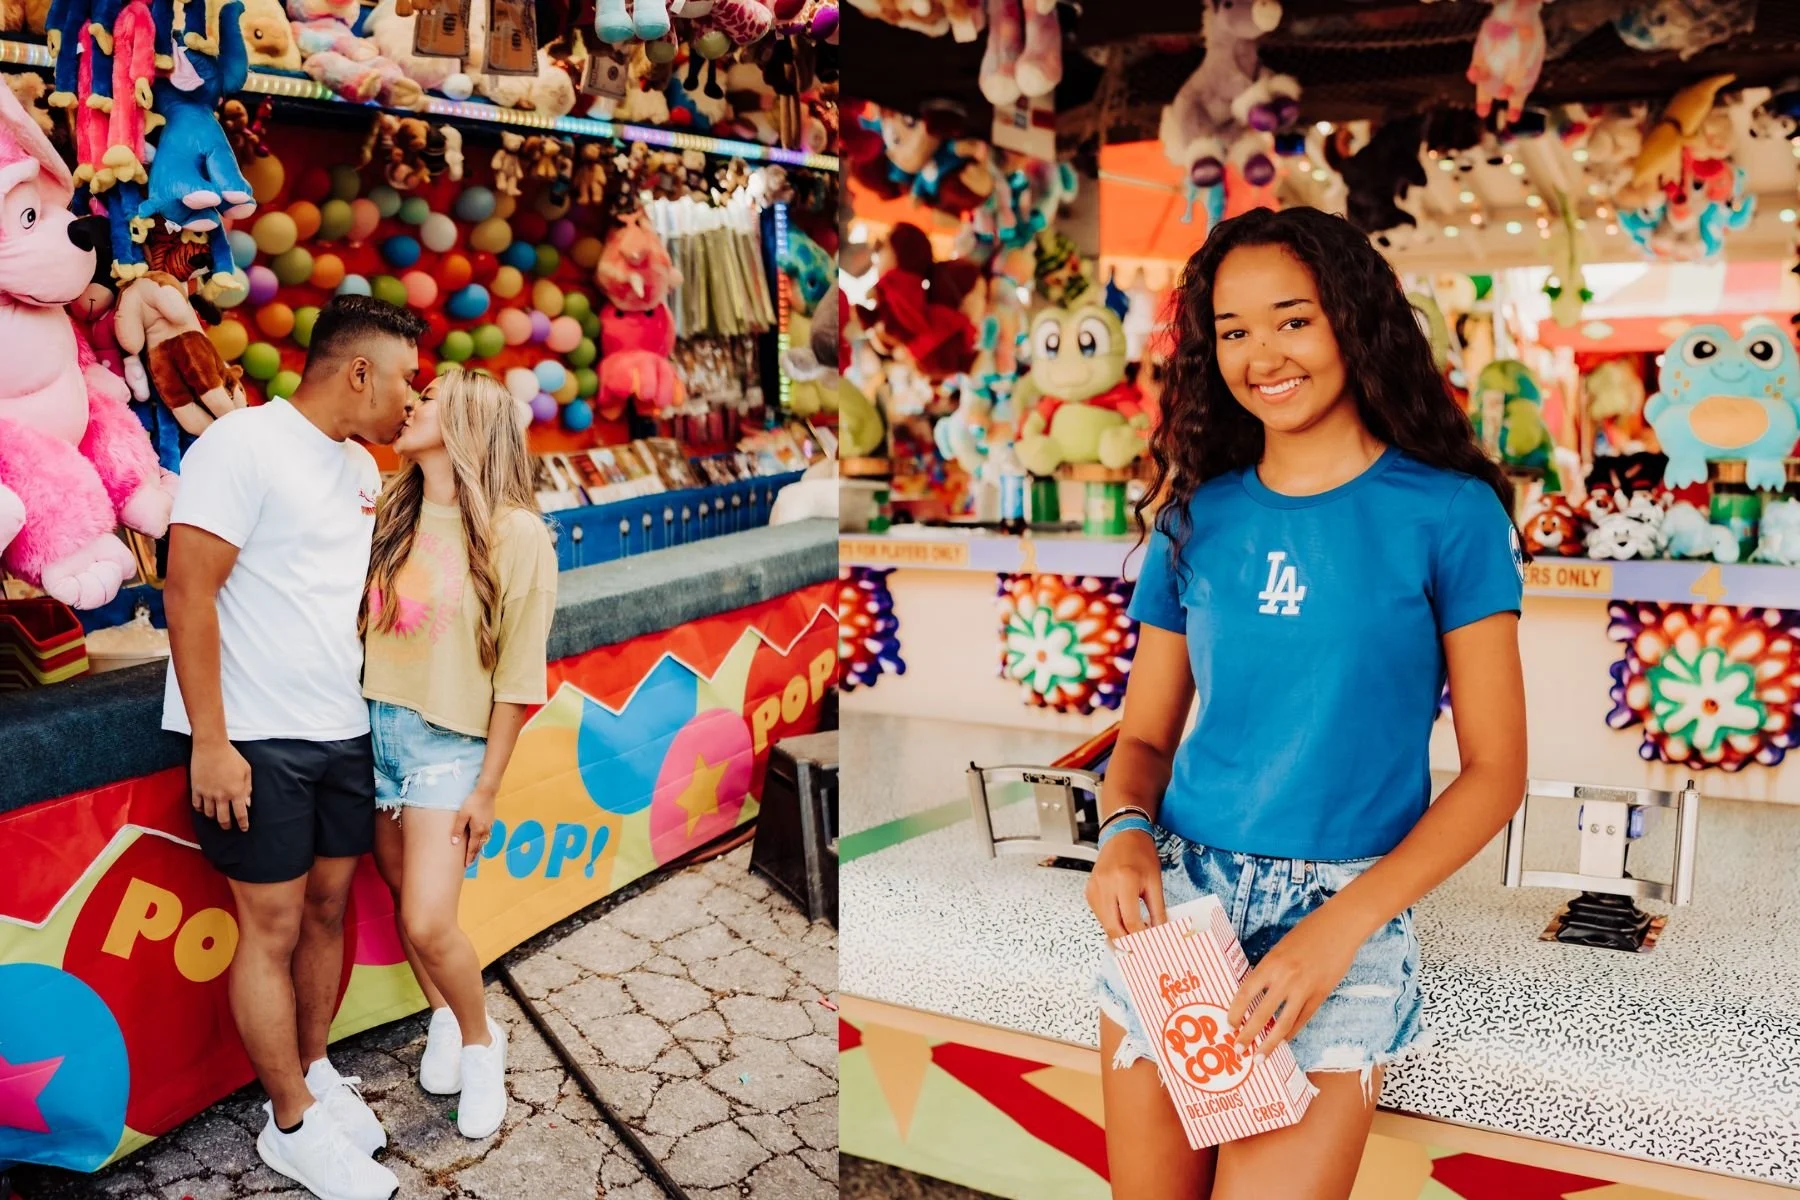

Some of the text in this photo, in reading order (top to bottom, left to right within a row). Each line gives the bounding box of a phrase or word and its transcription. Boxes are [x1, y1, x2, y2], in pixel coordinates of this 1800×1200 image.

[881, 544, 929, 561] PLAYERS
[932, 546, 961, 562] ONLY
[1258, 551, 1307, 615] LA
[1556, 567, 1601, 587] ONLY
[1690, 566, 1728, 602] 4
[751, 647, 836, 757] POP
[464, 818, 610, 879] POP!
[1158, 969, 1201, 1009] fresh
[1165, 1014, 1219, 1059] POP
[1186, 1092, 1286, 1123] DELICIOUS CRISP
